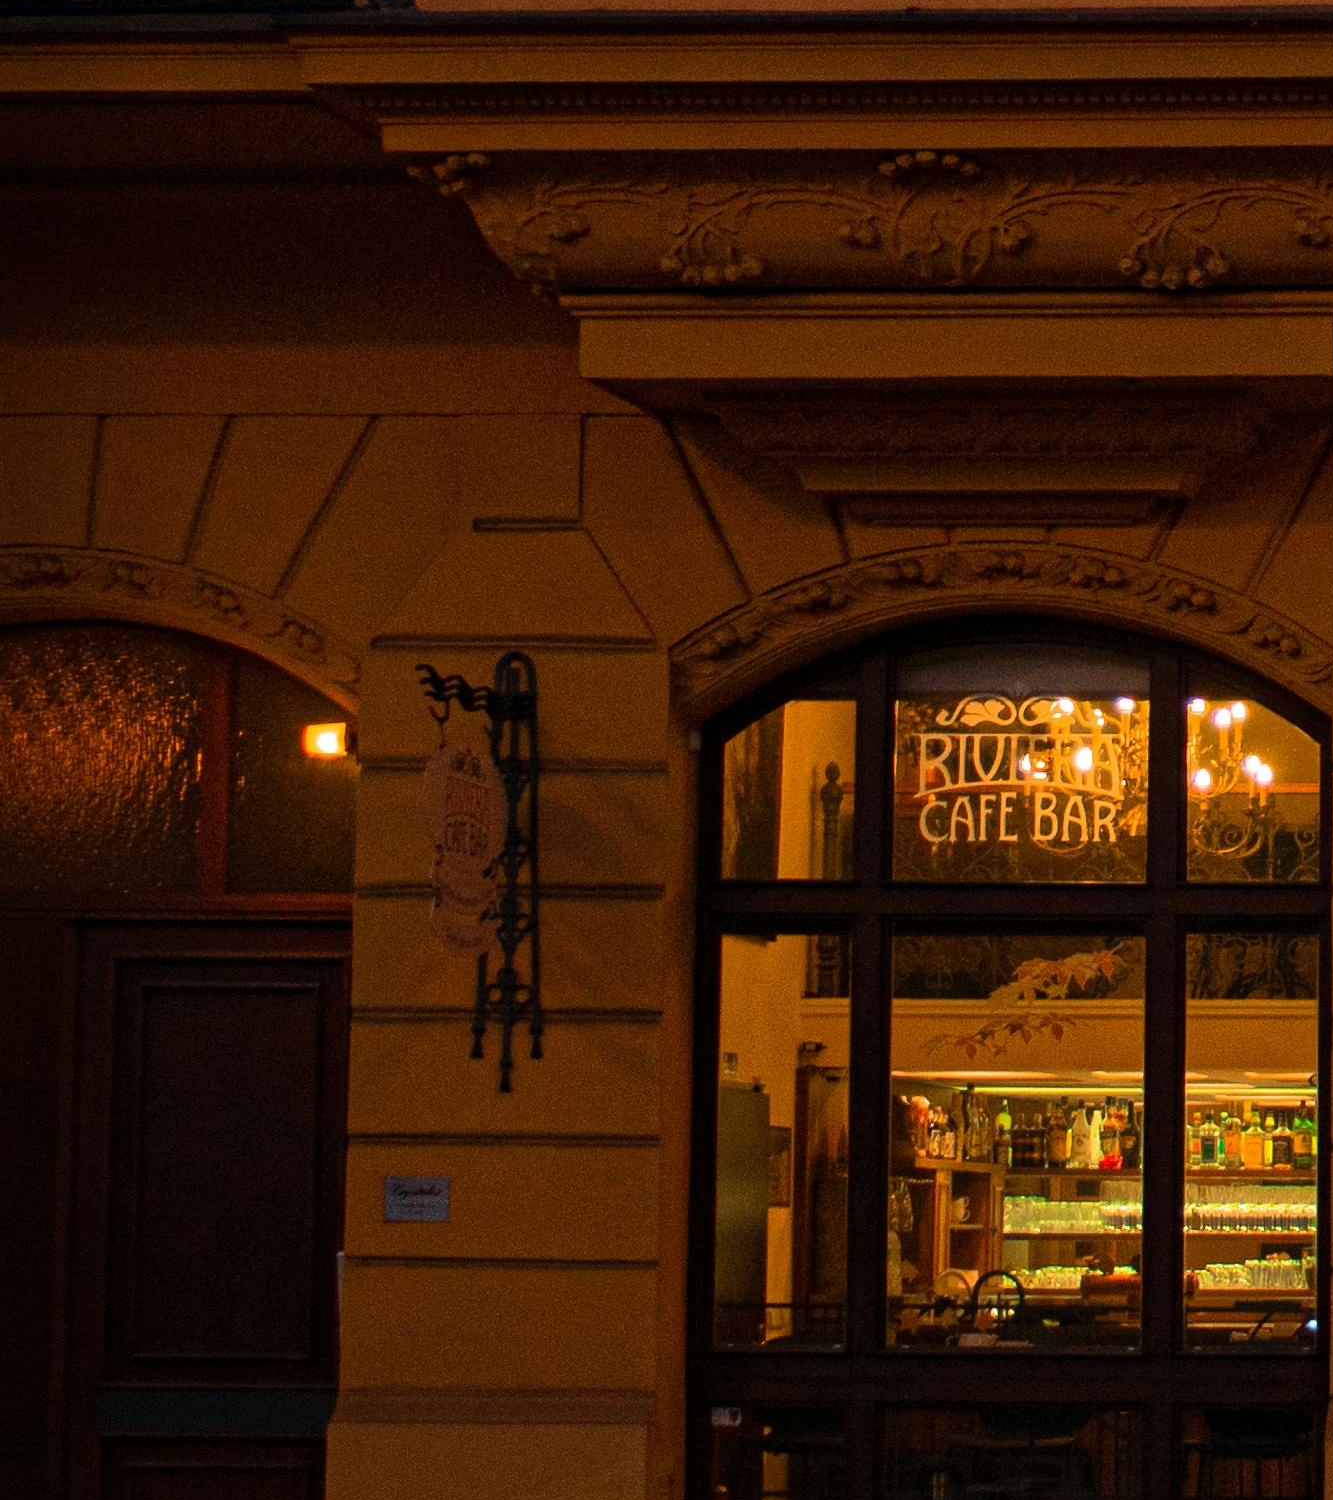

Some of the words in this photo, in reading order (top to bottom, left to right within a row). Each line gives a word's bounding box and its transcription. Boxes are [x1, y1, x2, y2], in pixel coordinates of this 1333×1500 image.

[914, 732, 1125, 801] RIVIERA
[919, 791, 1018, 844] CAFE
[1032, 791, 1119, 844] BAR
